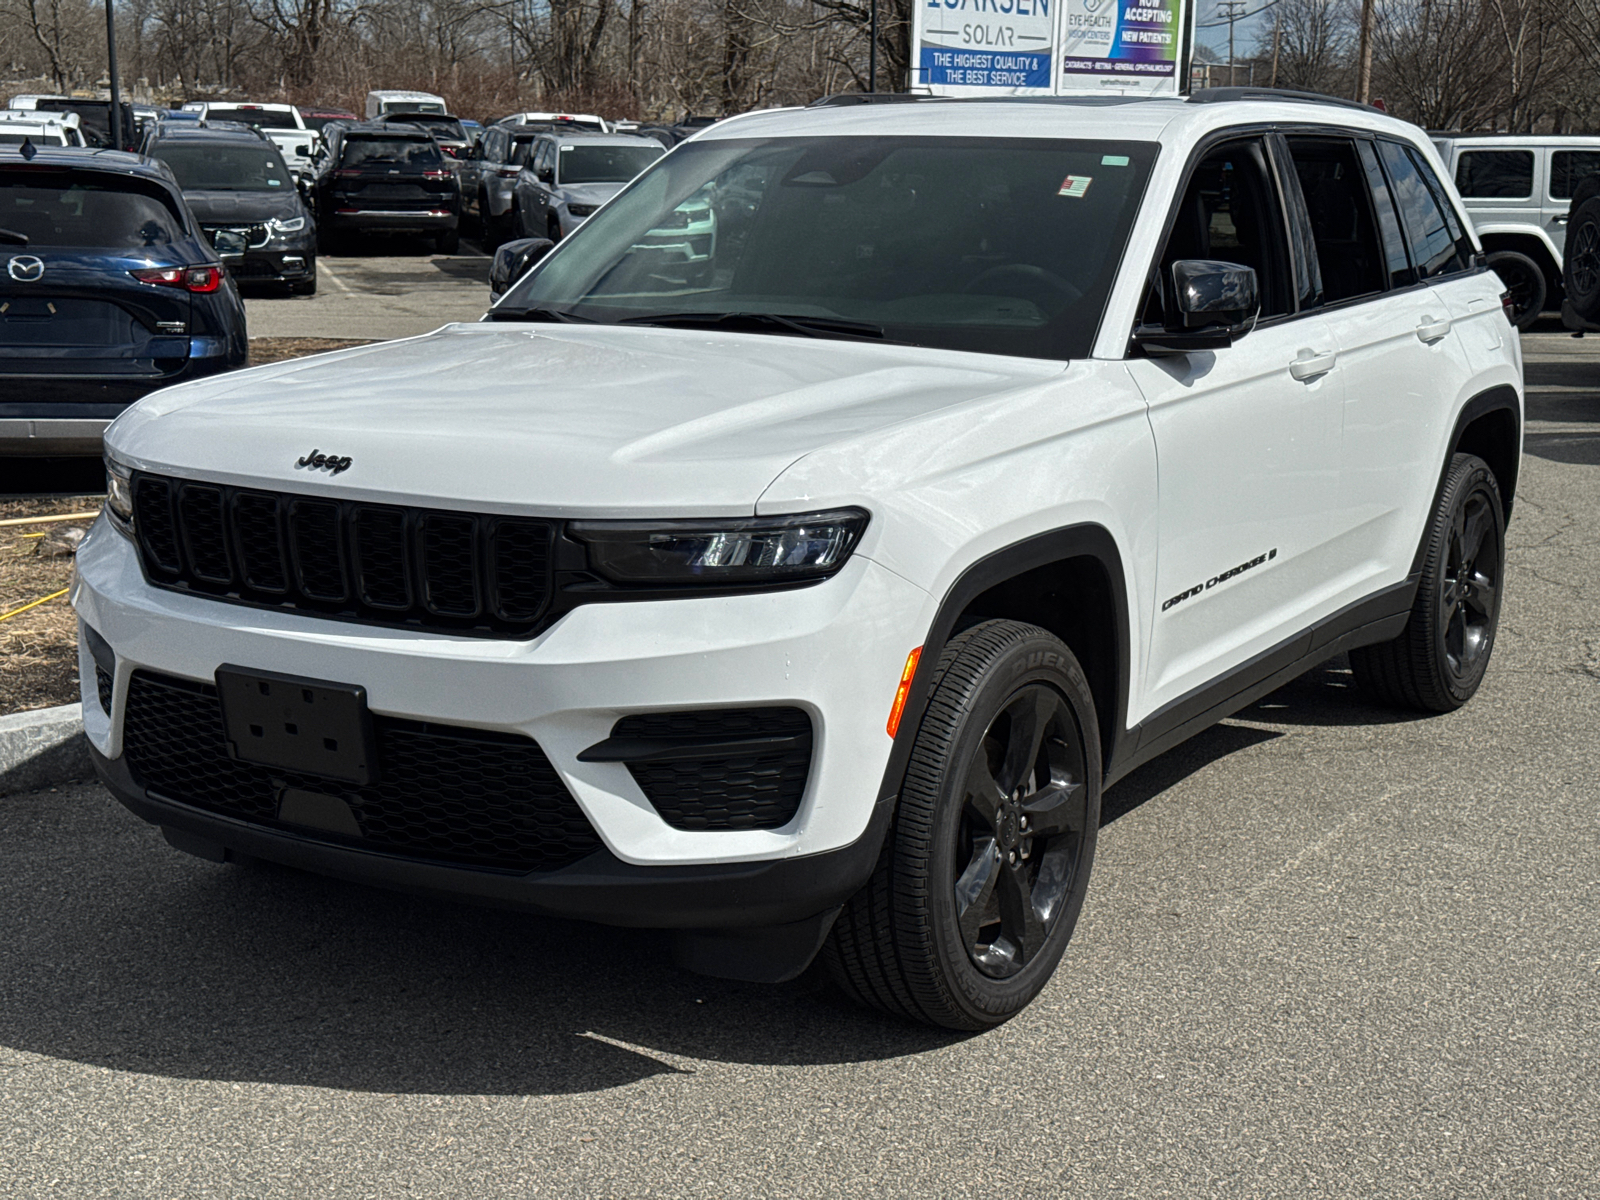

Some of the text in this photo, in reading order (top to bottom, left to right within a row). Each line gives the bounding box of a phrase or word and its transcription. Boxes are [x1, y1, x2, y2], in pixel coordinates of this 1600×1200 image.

[1069, 14, 1111, 27] EYE HEALTH
[1124, 8, 1172, 23] ACCEPTING
[962, 23, 1014, 46] SOLAR
[1087, 30, 1110, 40] CENTERS
[1121, 31, 1138, 42] NEW
[933, 52, 1039, 71] THE HIGHEST QUALITY &
[946, 69, 1027, 86] THE BEST SERVICE
[298, 448, 353, 475] Jeep
[1162, 553, 1267, 612] GRAND CHEROKEE
[1012, 651, 1091, 706] DUELER
